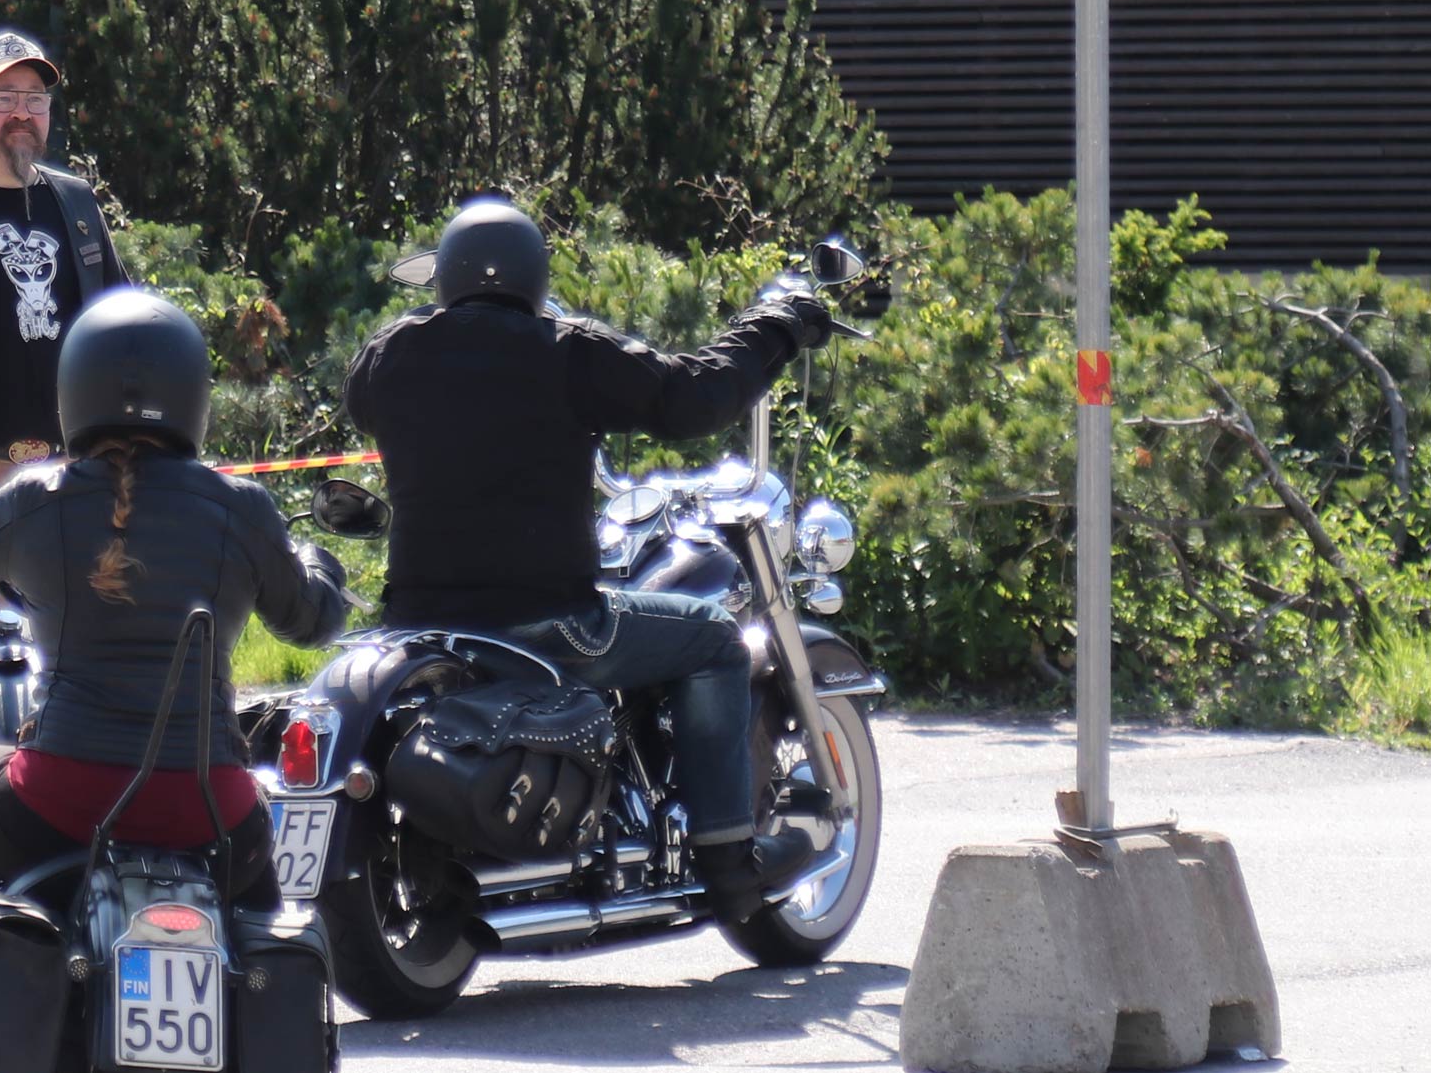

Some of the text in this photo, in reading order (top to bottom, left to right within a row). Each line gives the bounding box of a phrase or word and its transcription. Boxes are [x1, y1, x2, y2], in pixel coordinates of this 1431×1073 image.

[280, 810, 328, 846] FF
[123, 979, 149, 995] FIN
[164, 958, 212, 1005] IV
[125, 1007, 213, 1056] 550
